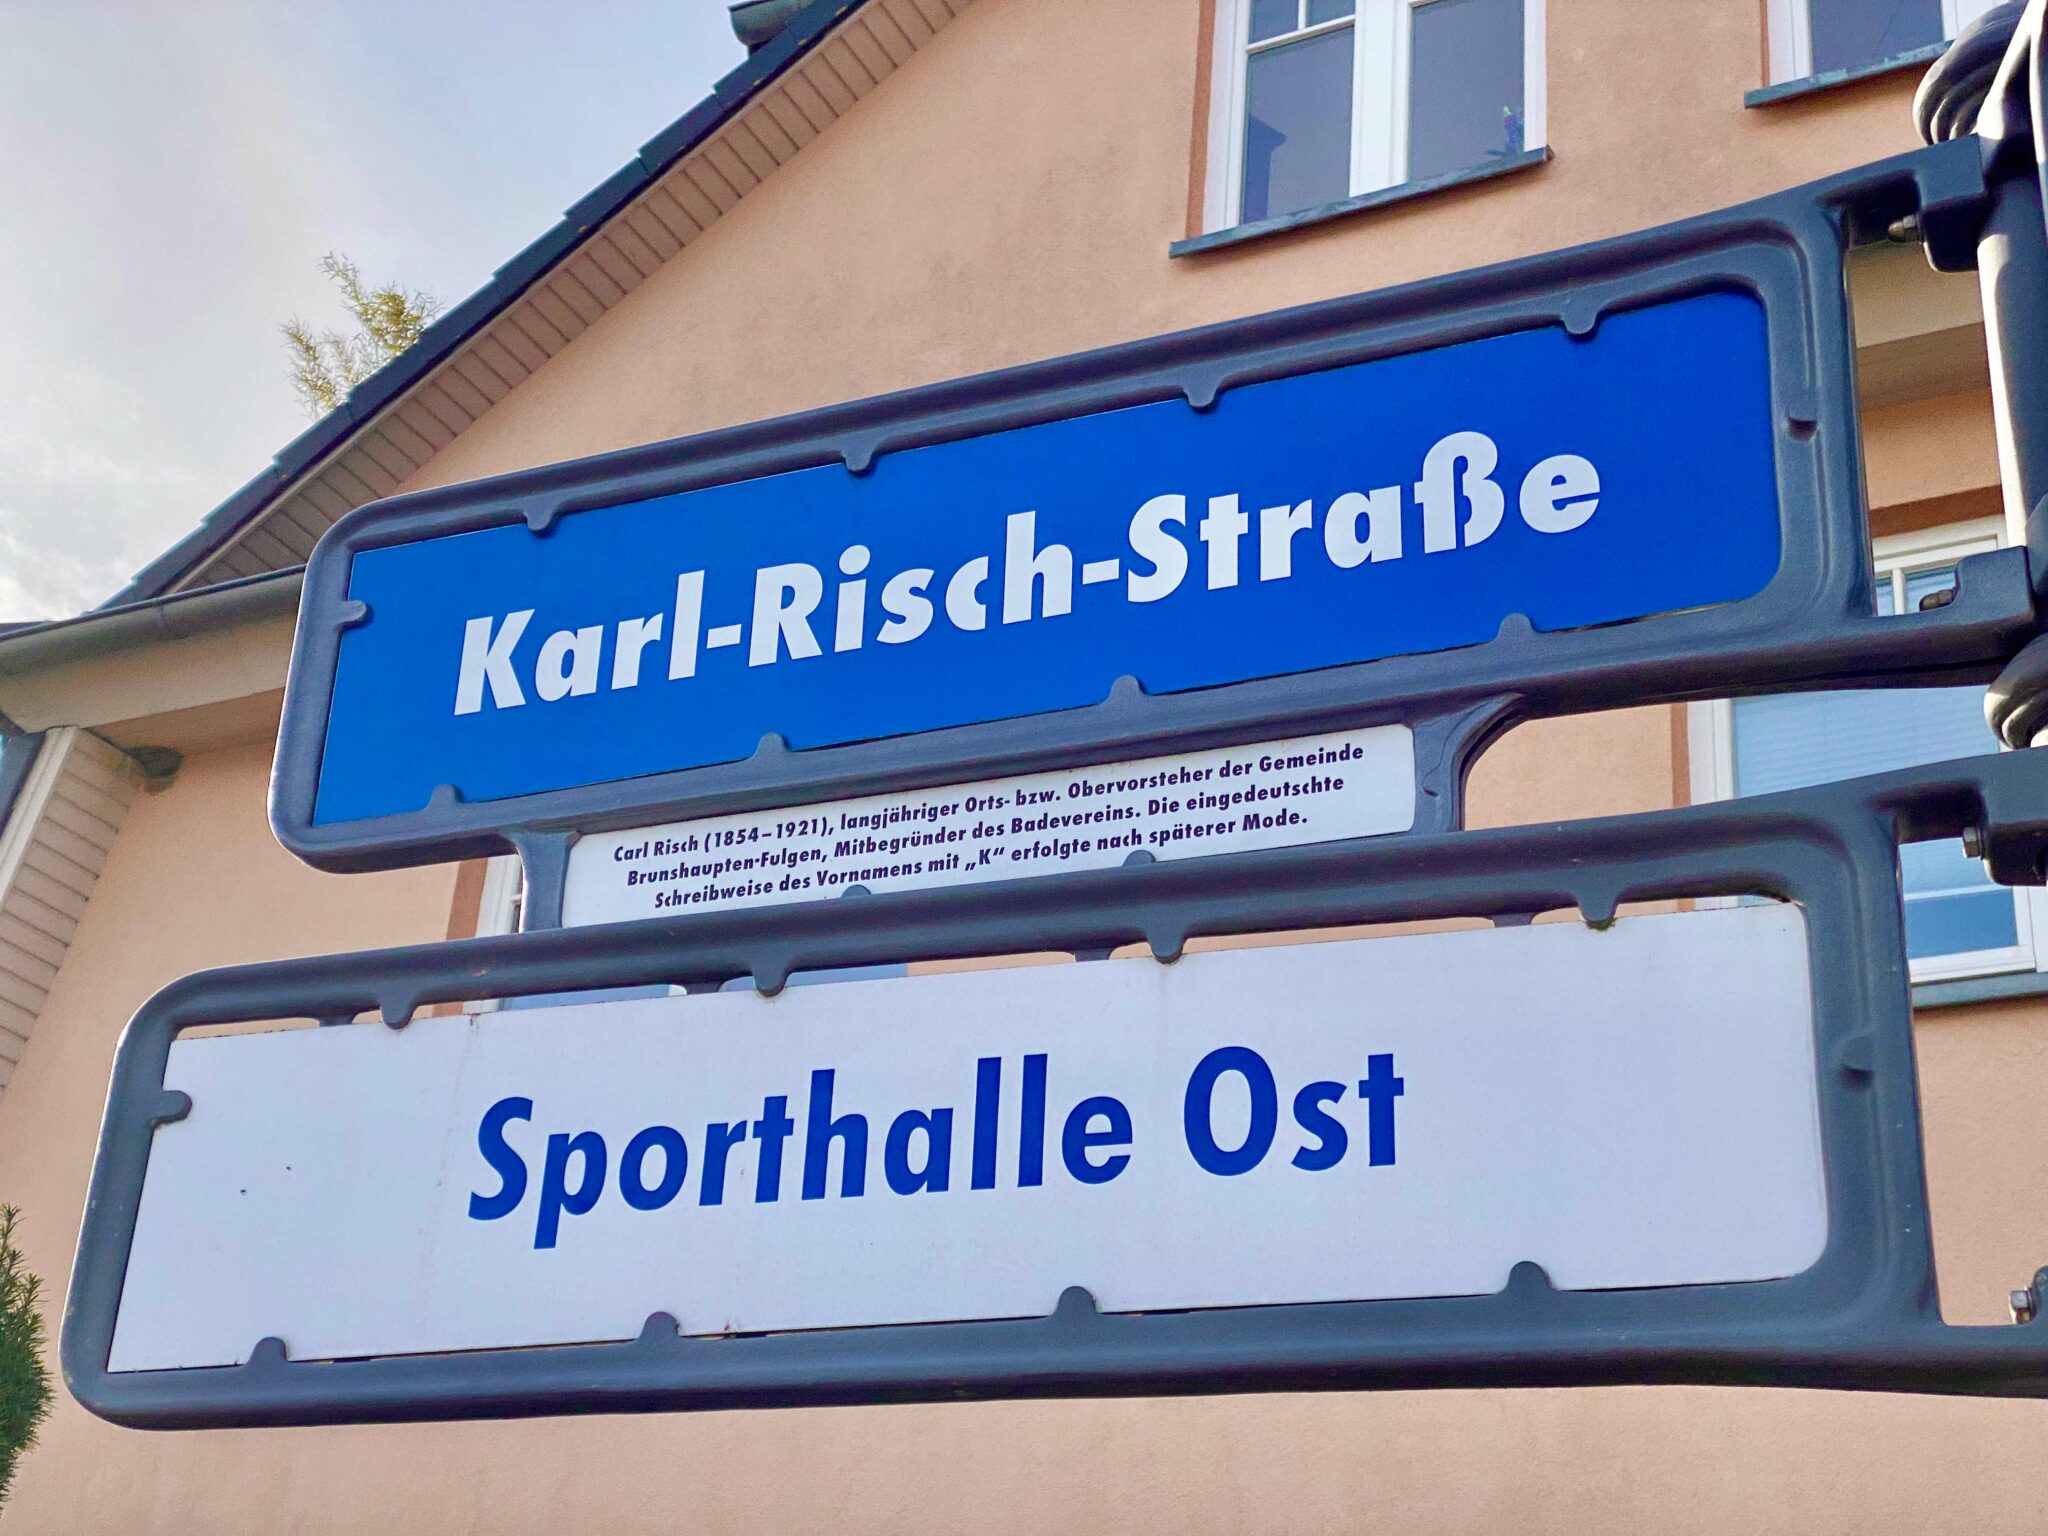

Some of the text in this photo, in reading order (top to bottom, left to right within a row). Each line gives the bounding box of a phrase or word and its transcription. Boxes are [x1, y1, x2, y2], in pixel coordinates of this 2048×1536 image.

[455, 432, 1599, 715] Karl-Risch-Straße
[614, 842, 648, 861] Carl
[654, 835, 698, 856] Risch
[841, 803, 959, 830] langjähriger
[965, 796, 1010, 812] Orts-
[1016, 789, 1060, 806] bzw.
[1068, 767, 1212, 798] Obervorsteher
[1219, 760, 1252, 777] der
[1260, 743, 1363, 772] Gemeinde
[628, 776, 1343, 885] Brunshaupten-Fulgen, Mitbegründer des Badevereins. Die eingedeutschte
[655, 880, 773, 908] Schreibweise
[779, 874, 810, 891] des
[817, 862, 921, 886] Vornamens
[928, 853, 959, 872] mit
[1012, 839, 1090, 861] erfolgte
[1098, 829, 1141, 850] nach
[1150, 821, 1235, 847] späterer
[1243, 808, 1307, 831] Mode.
[468, 1046, 1404, 1249] Sporthalle Ost
